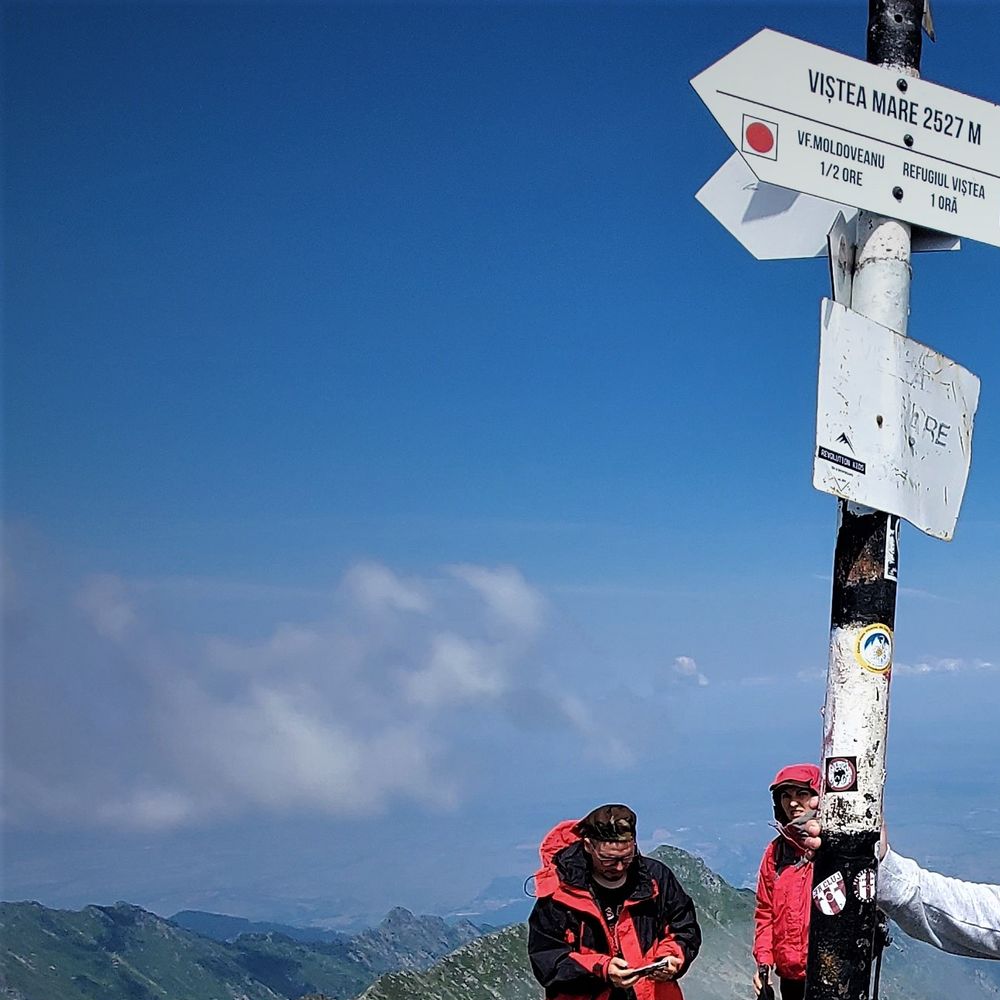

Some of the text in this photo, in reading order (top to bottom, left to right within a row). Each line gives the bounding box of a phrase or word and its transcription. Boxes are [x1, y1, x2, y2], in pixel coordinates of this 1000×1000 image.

[808, 69, 982, 146] VIȘTEA MARE 2527 M
[797, 130, 885, 169] VF.MOLDOVEANU
[820, 161, 863, 187] 1/2 ORE
[902, 161, 986, 200] REFUGIUL VIȘTEA
[930, 193, 958, 214] 1 ORĂ
